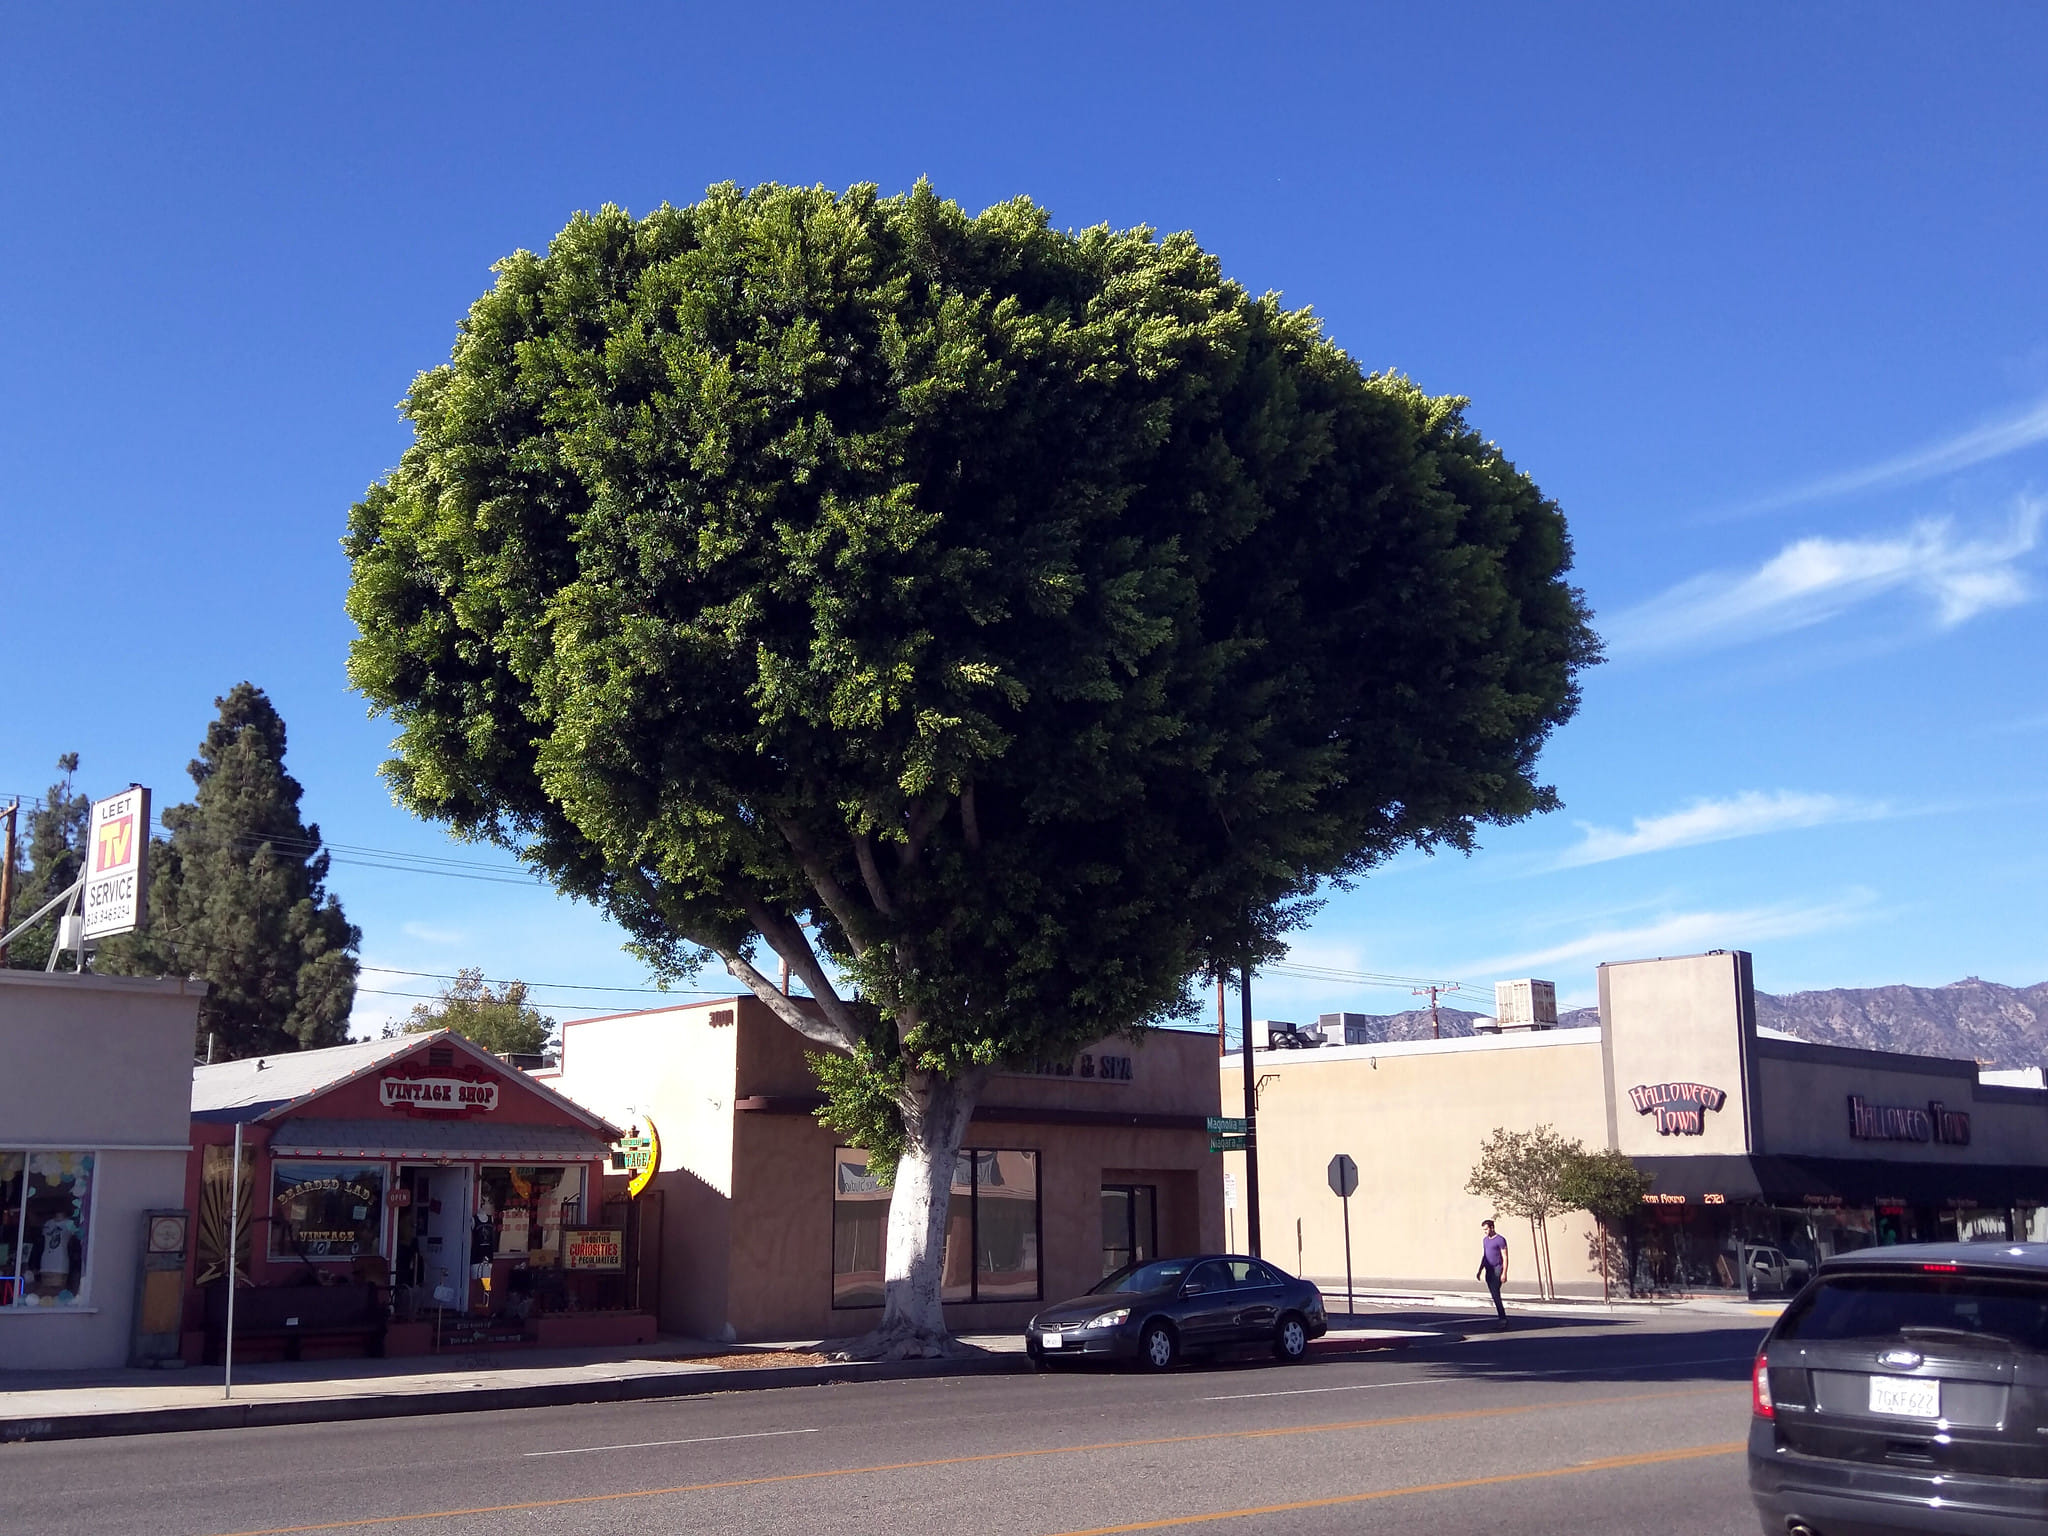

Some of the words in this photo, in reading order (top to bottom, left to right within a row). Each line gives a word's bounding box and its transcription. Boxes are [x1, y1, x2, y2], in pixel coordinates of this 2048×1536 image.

[102, 798, 132, 819] LEET
[100, 822, 131, 869] TV
[90, 876, 133, 907] SERVICE
[1081, 1054, 1095, 1078] &
[1101, 1055, 1134, 1080] SPA
[385, 1082, 451, 1102] VINTAGE
[458, 1086, 494, 1104] SHOP
[1629, 1083, 1722, 1112] HALLOWEEN
[1207, 1116, 1237, 1132] Magnolia
[1653, 1106, 1700, 1132] TOWN
[1851, 1095, 1929, 1140] HALLOWEEN
[1933, 1103, 1970, 1142] TOWN
[1210, 1136, 1236, 1150] Niagara
[277, 1179, 340, 1205] BEARDED
[1703, 1193, 1725, 1204] 2921
[299, 1231, 355, 1242] VINTAGE
[569, 1243, 618, 1257] CURIOSITIES
